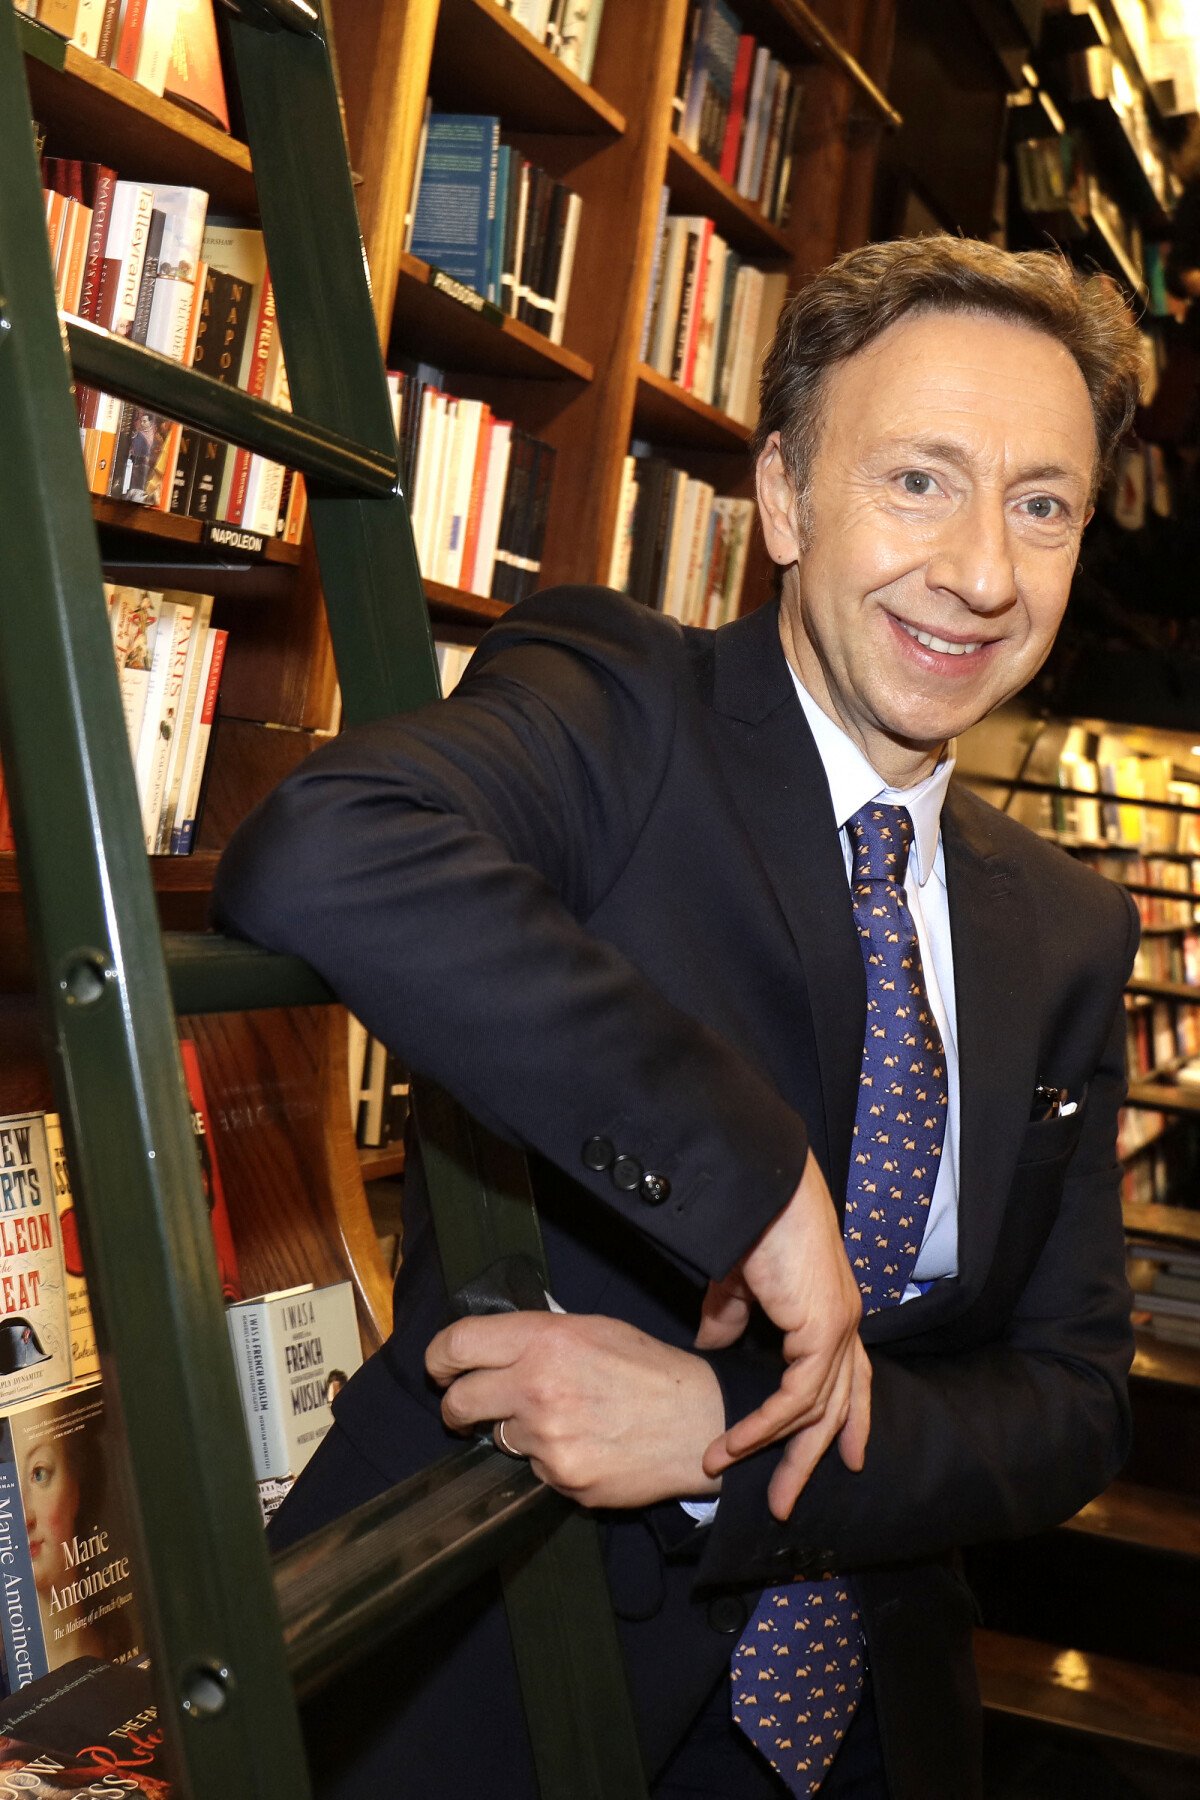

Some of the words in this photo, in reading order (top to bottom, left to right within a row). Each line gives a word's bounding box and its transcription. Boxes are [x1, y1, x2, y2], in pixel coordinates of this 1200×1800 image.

[210, 527, 263, 551] NAPOLEON
[169, 613, 192, 697] PARIS
[248, 1318, 259, 1336] WAS
[287, 1302, 308, 1330] WAS
[252, 1344, 264, 1376] FRENCH
[285, 1337, 324, 1374] FRENCH
[256, 1378, 268, 1411] MUSLIM
[291, 1381, 330, 1416] MUSLIM
[0, 1496, 19, 1565] Marie
[60, 1525, 109, 1571] Marie
[49, 1556, 130, 1617] Antoinette
[53, 1627, 65, 1641] The
[66, 1615, 88, 1634] Making
